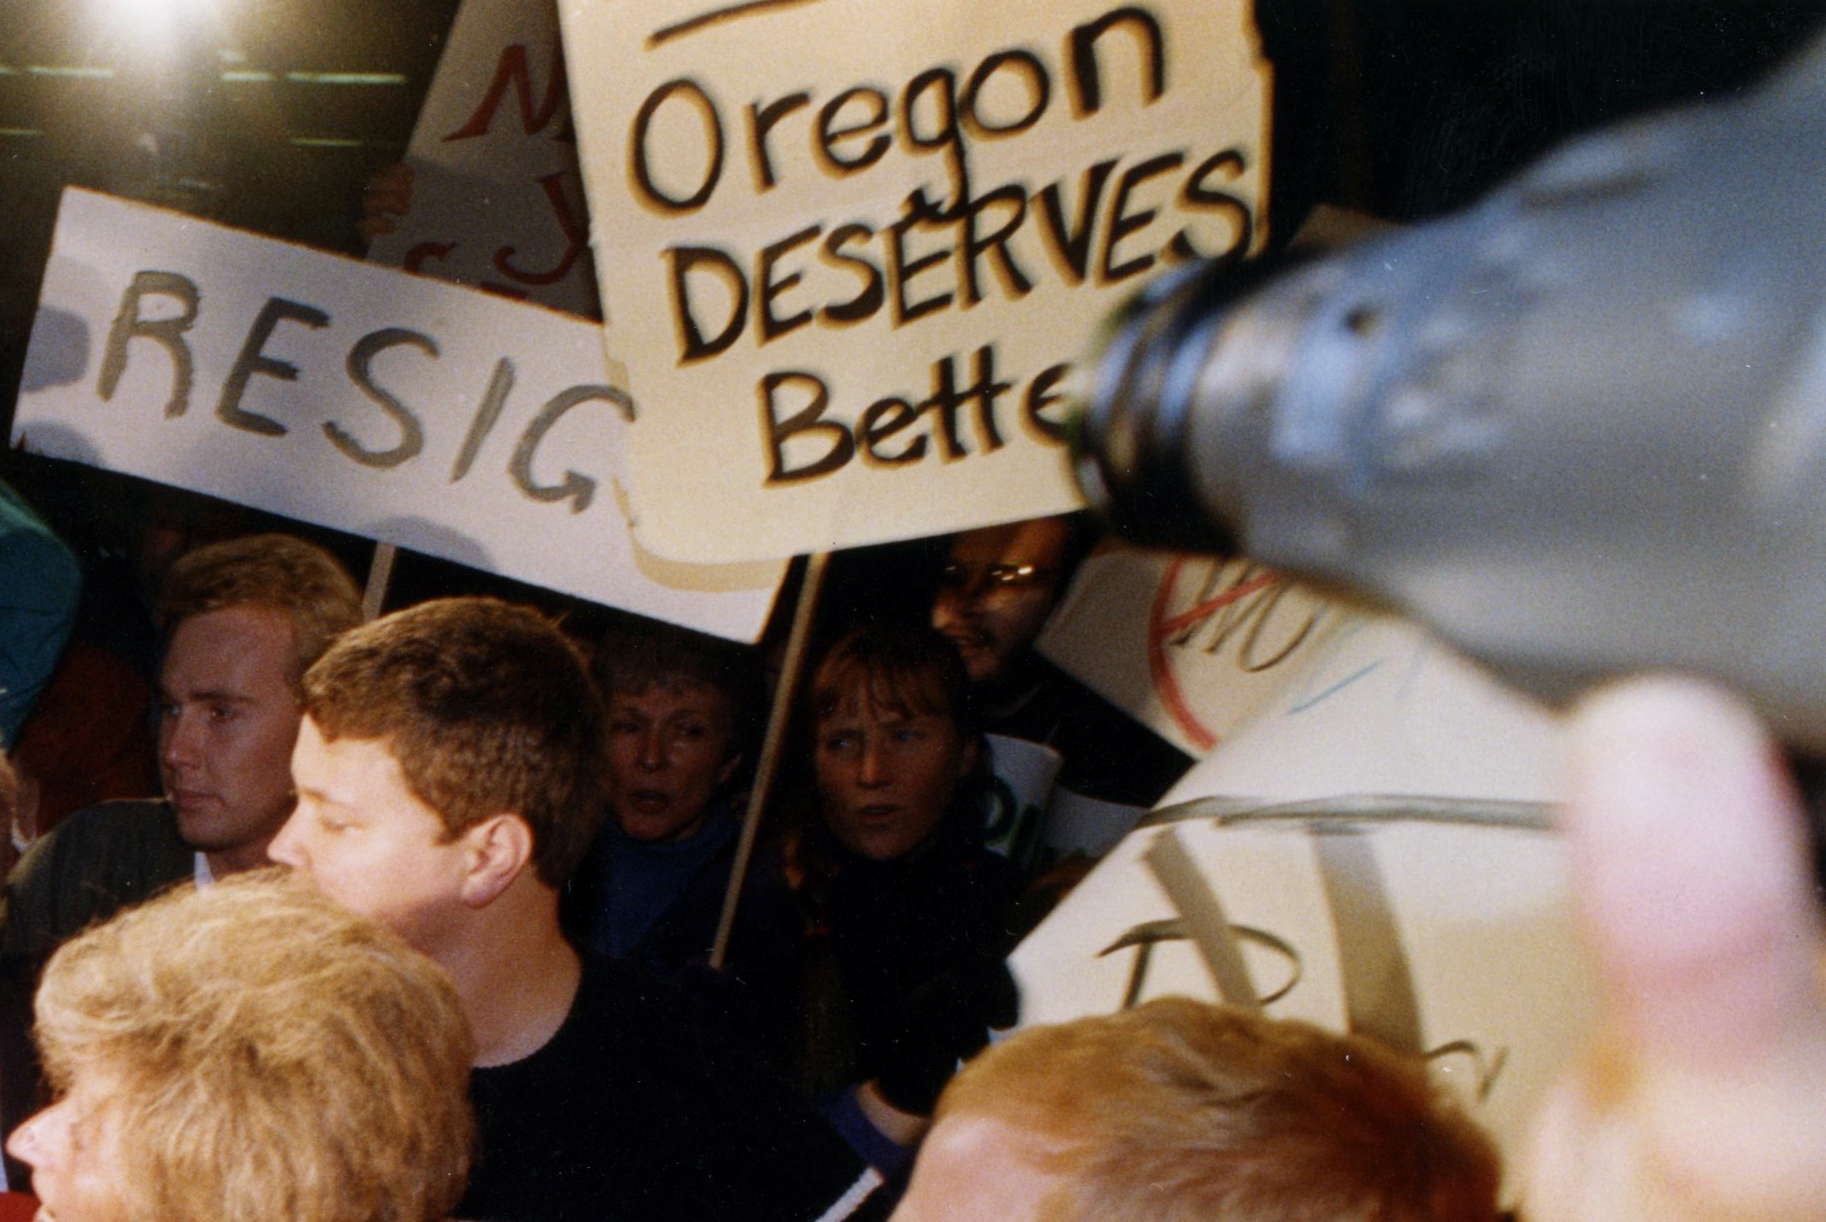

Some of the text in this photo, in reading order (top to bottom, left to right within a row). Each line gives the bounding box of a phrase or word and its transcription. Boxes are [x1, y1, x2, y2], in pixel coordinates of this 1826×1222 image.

[627, 6, 1167, 231] Oregon
[658, 150, 1253, 368] DESERVES
[96, 270, 635, 514] RESIG
[756, 345, 1072, 488] Bette
